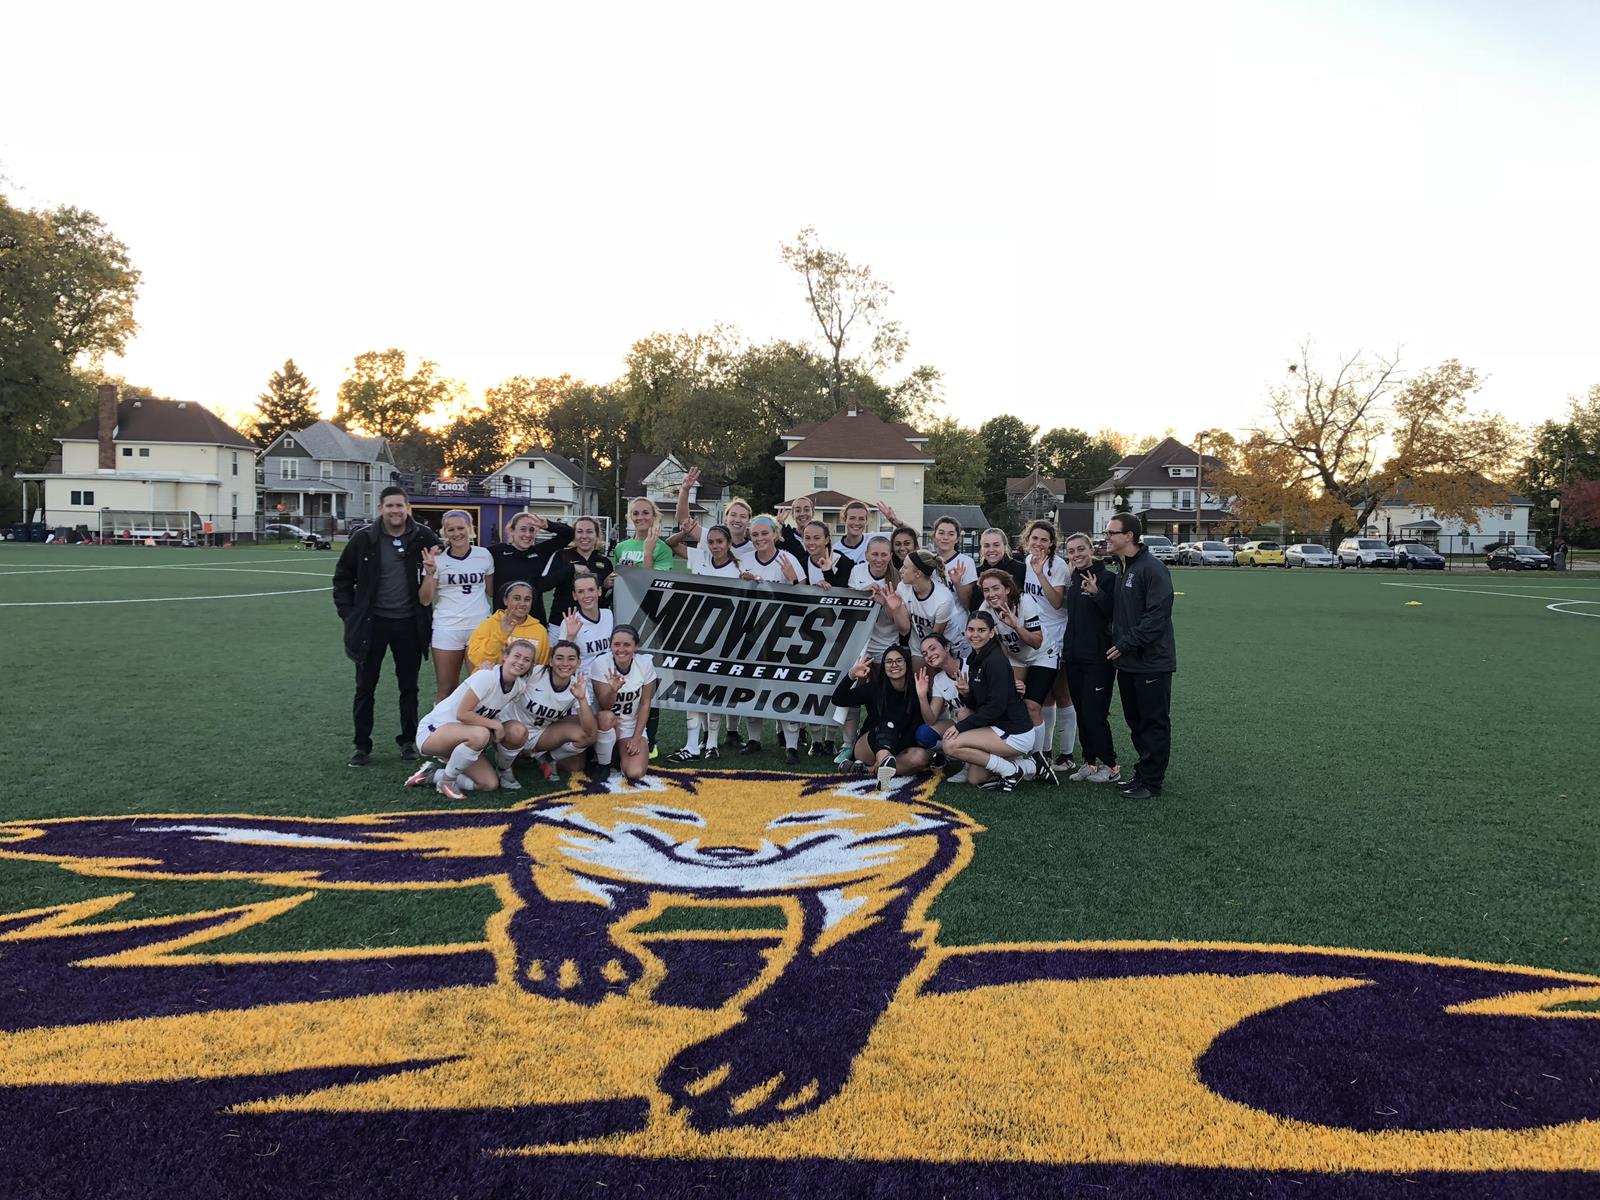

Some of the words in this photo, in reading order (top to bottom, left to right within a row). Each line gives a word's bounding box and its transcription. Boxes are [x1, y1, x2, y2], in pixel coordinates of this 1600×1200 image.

[438, 483, 465, 491] KNOX
[447, 572, 485, 585] KNOX
[654, 580, 675, 589] THE
[1025, 582, 1044, 597] NOX
[819, 597, 842, 605] EST.
[847, 598, 874, 607] 1921
[630, 589, 872, 667] MIDWEST
[661, 656, 837, 684] NFERENCE
[616, 687, 641, 702] NOX
[656, 678, 833, 716] AMPION
[526, 699, 564, 720] KNOX
[612, 702, 633, 716] 28
